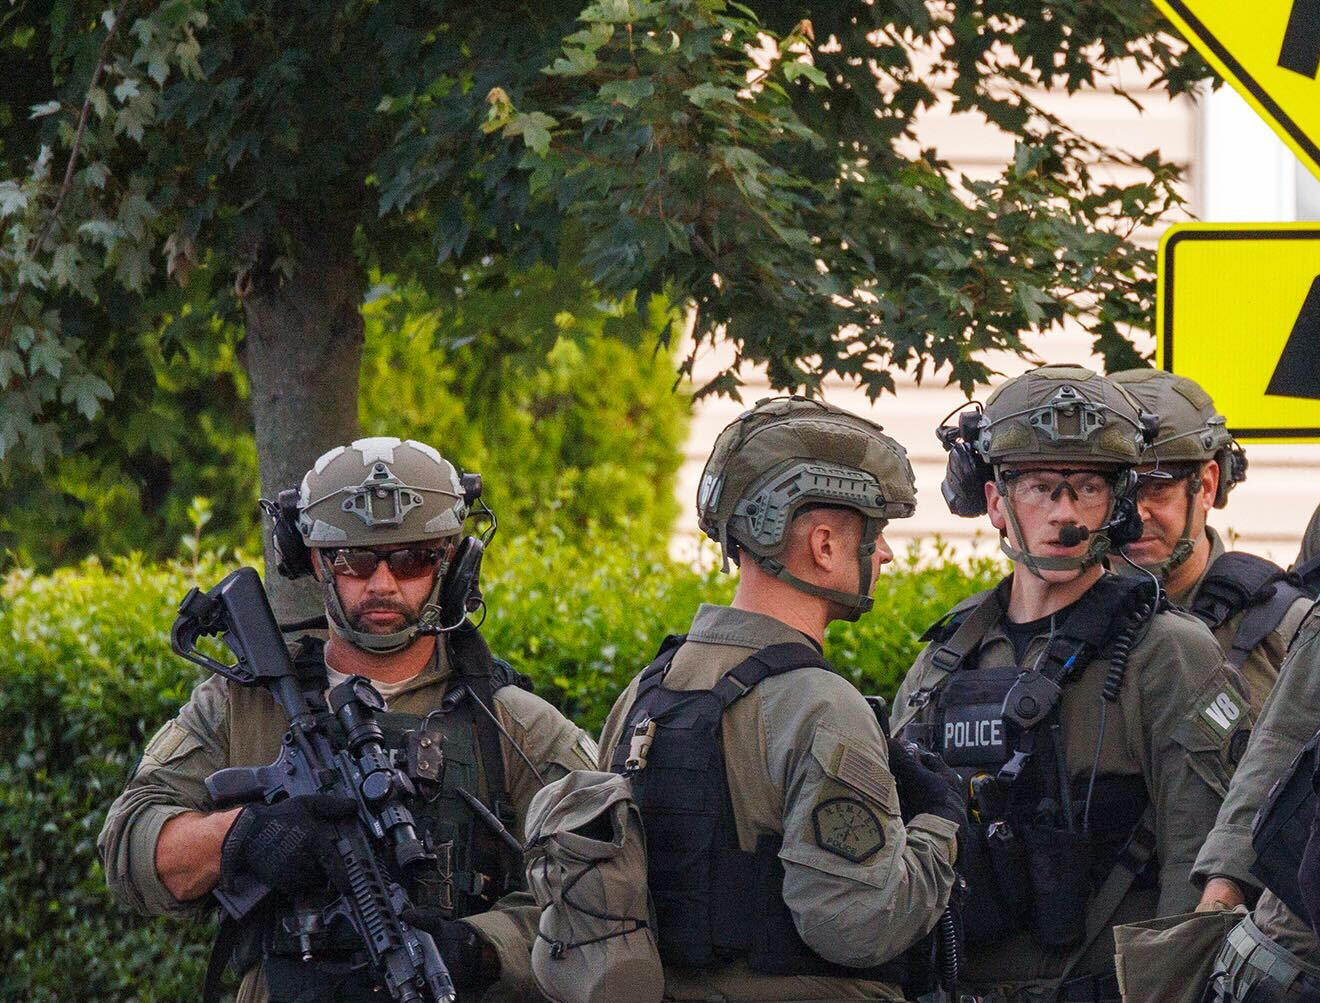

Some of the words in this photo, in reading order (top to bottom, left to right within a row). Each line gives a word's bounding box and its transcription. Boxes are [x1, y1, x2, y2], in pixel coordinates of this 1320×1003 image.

[1205, 692, 1240, 730] V8
[944, 719, 1003, 749] POLICE
[826, 836, 858, 855] POLICE
